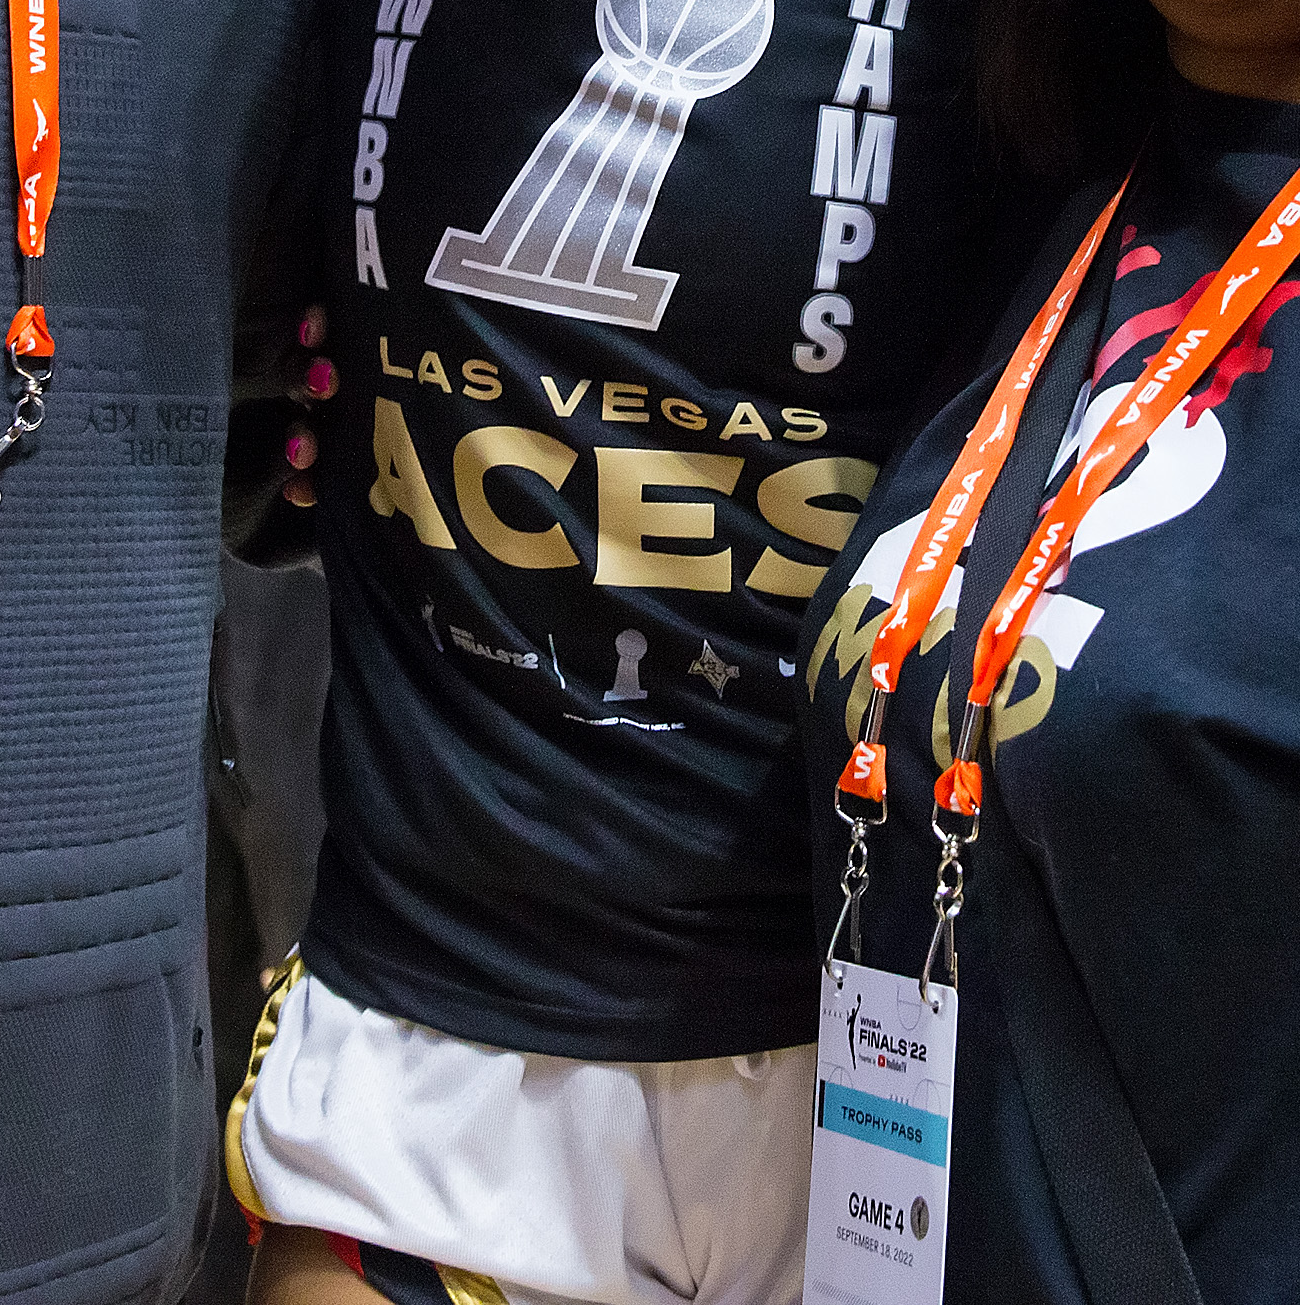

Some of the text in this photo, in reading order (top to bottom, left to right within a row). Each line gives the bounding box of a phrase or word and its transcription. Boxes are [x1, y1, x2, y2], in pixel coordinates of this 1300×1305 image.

[379, 336, 830, 443] LAS VEGAS
[1122, 327, 1210, 430] WNBA
[368, 395, 880, 599] ACES
[915, 467, 984, 574] WNBA
[859, 1016, 882, 1031] WNBA
[859, 1027, 927, 1063] FINALS'22
[840, 1105, 923, 1145] TROPHY PASS
[848, 1191, 905, 1236] GAME 4
[836, 1225, 879, 1255] SEPTEMBER
[893, 1246, 914, 1268] 2022
